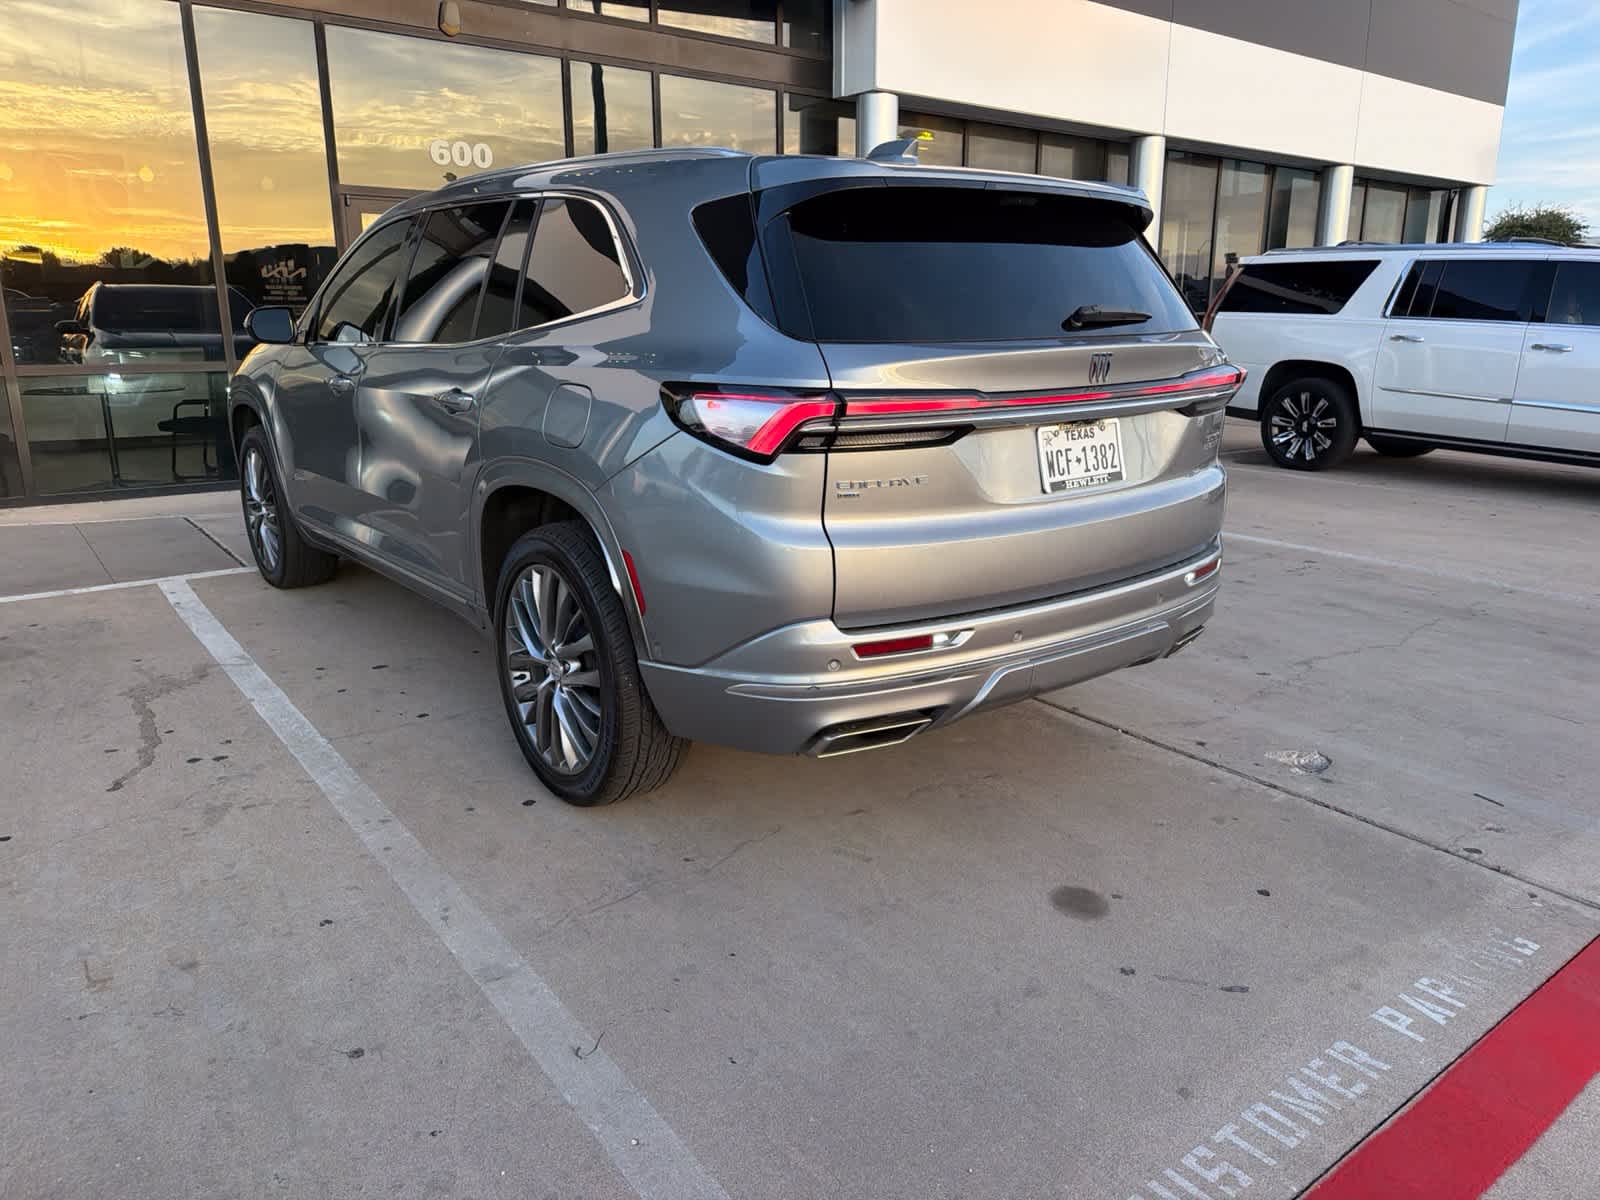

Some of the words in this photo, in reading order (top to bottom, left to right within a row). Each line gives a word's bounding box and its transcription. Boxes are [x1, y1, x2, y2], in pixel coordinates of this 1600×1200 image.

[430, 140, 493, 168] 600
[1065, 427, 1095, 441] TEXAS
[1046, 448, 1072, 478] WCF
[1081, 442, 1118, 472] 1382
[1127, 1039, 1392, 1200] USTOMER
